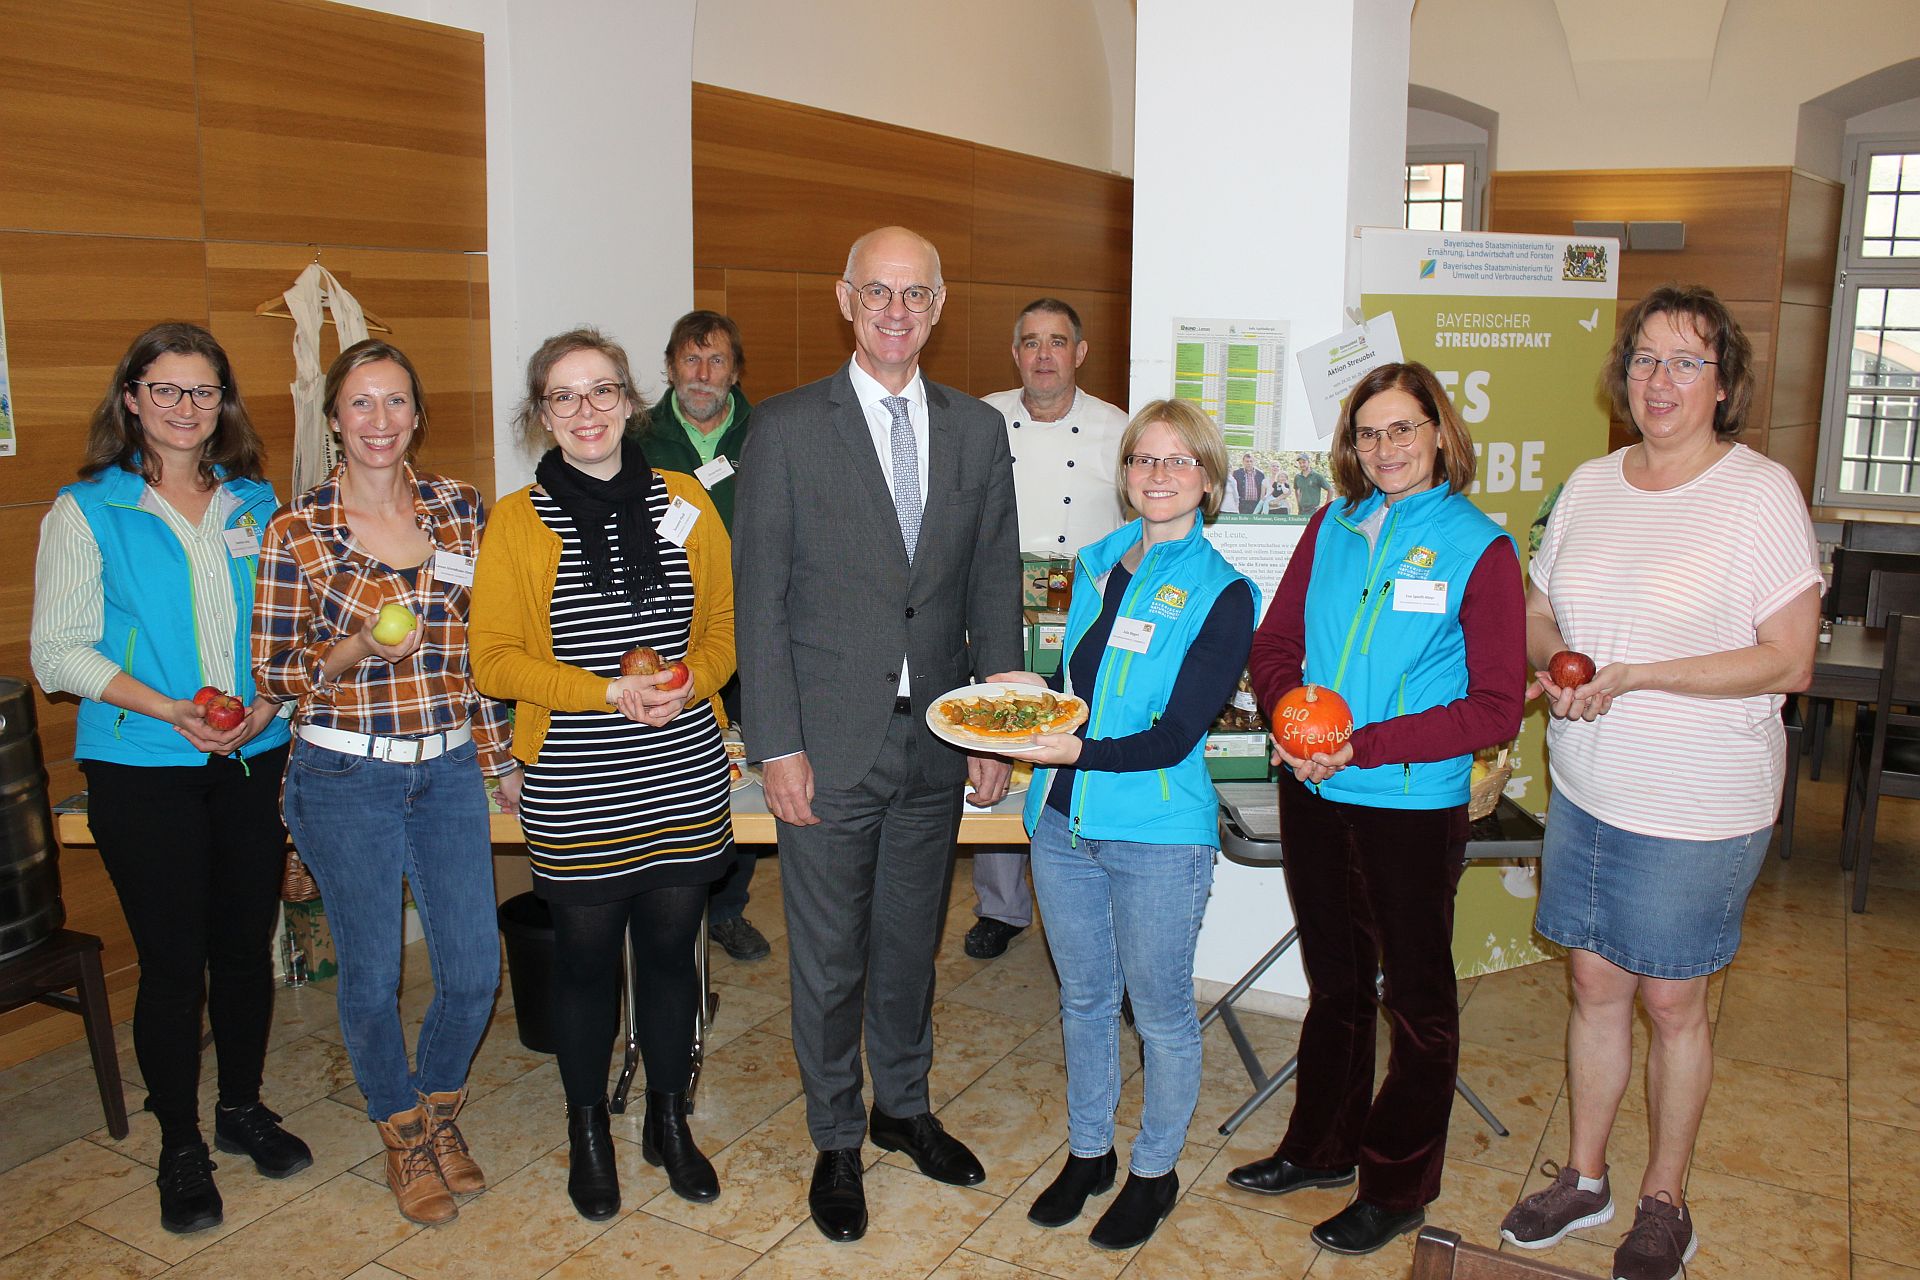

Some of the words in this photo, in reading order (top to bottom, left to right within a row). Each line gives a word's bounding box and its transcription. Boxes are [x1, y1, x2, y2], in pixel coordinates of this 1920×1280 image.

[1444, 239, 1483, 249] Bayerisches
[1485, 241, 1543, 250] Staatsministerium
[1545, 242, 1554, 250] für
[1428, 248, 1464, 258] Ernährung,
[1467, 249, 1514, 258] Landwirtschaft
[1530, 251, 1554, 259] Forsten
[1443, 262, 1482, 271] Bayerisches
[1484, 264, 1542, 272] Staatsministerium
[1453, 271, 1479, 279] Umwelt
[1480, 272, 1493, 280] und
[1495, 272, 1552, 281] Verbraucherschutz
[1436, 312, 1530, 328] BAYERISCHER
[1435, 332, 1552, 348] STREUOBSTPAKT
[1327, 364, 1346, 377] Aktion
[1347, 350, 1376, 368] Streuobst
[1205, 530, 1222, 538] iebe
[1225, 530, 1248, 539] Leute,
[1282, 706, 1310, 722] BIO
[1283, 720, 1354, 744] Streuobst
